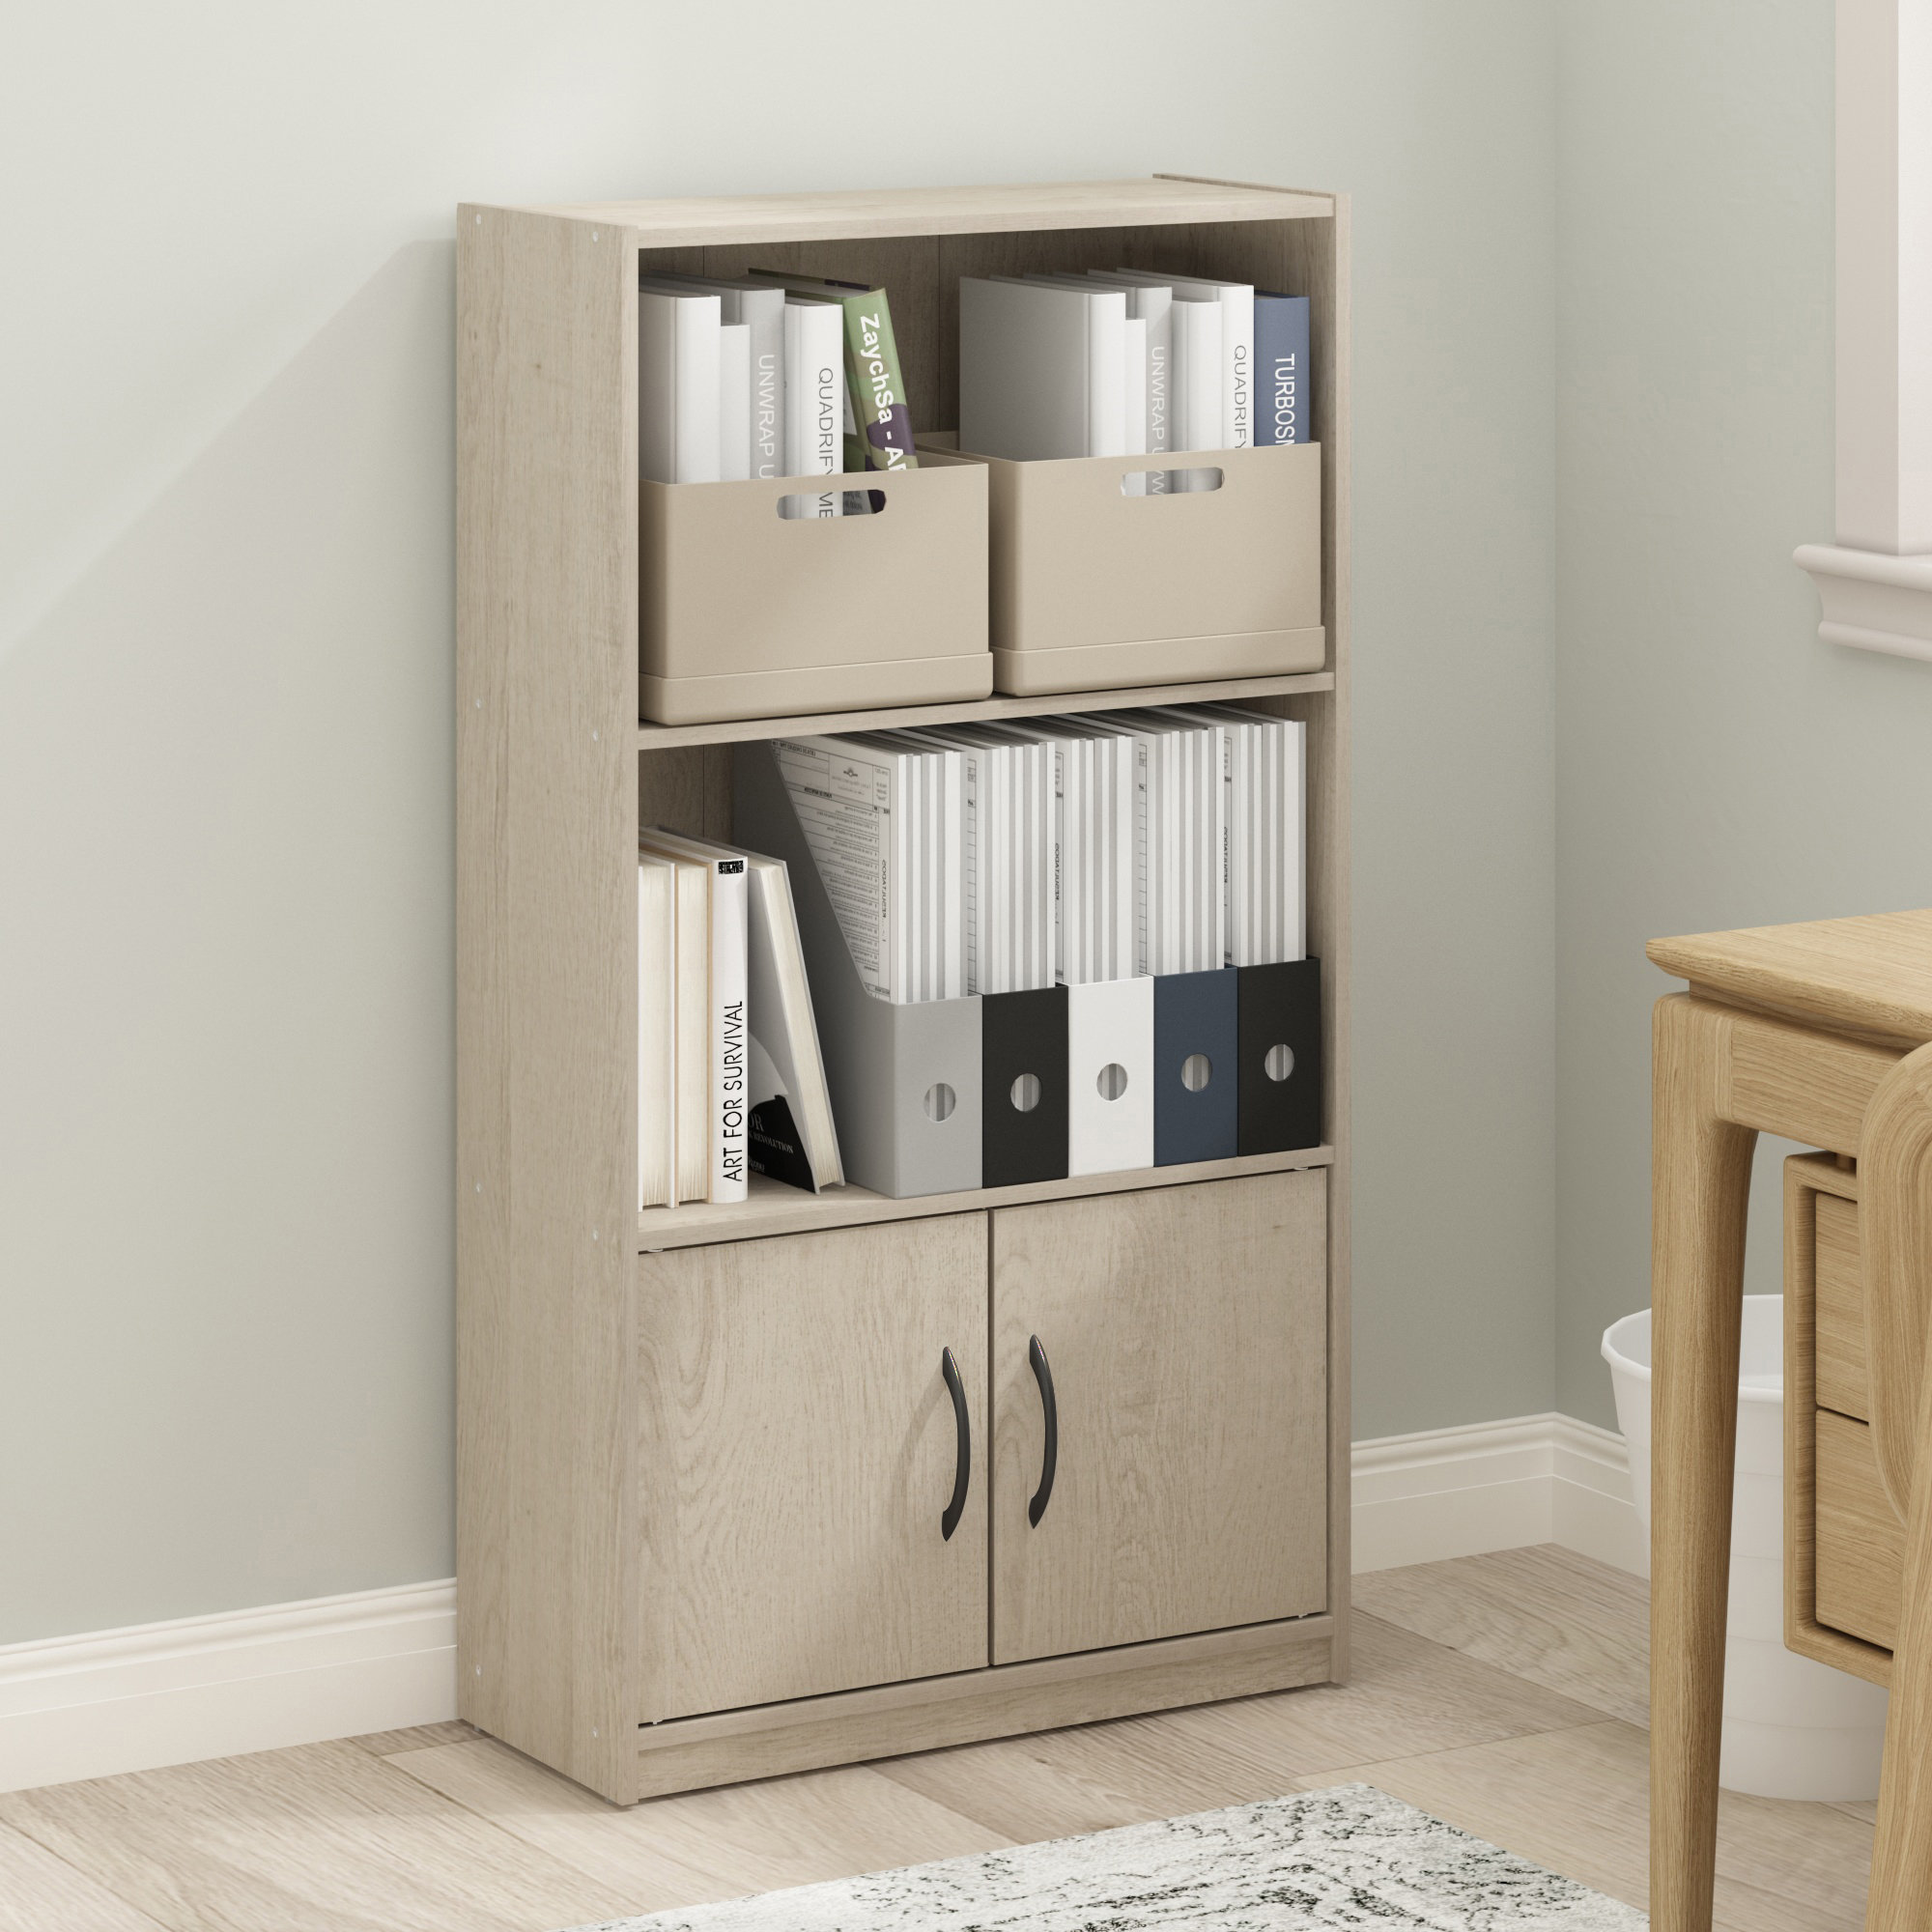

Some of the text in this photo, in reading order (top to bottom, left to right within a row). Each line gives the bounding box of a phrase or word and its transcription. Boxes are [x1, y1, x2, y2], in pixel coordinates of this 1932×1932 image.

[758, 354, 775, 457] UNWRAP
[860, 312, 895, 424] ZaychSa
[1151, 346, 1165, 440] UNWRAP
[723, 1001, 743, 1181] ART FOR SURVIVAL
